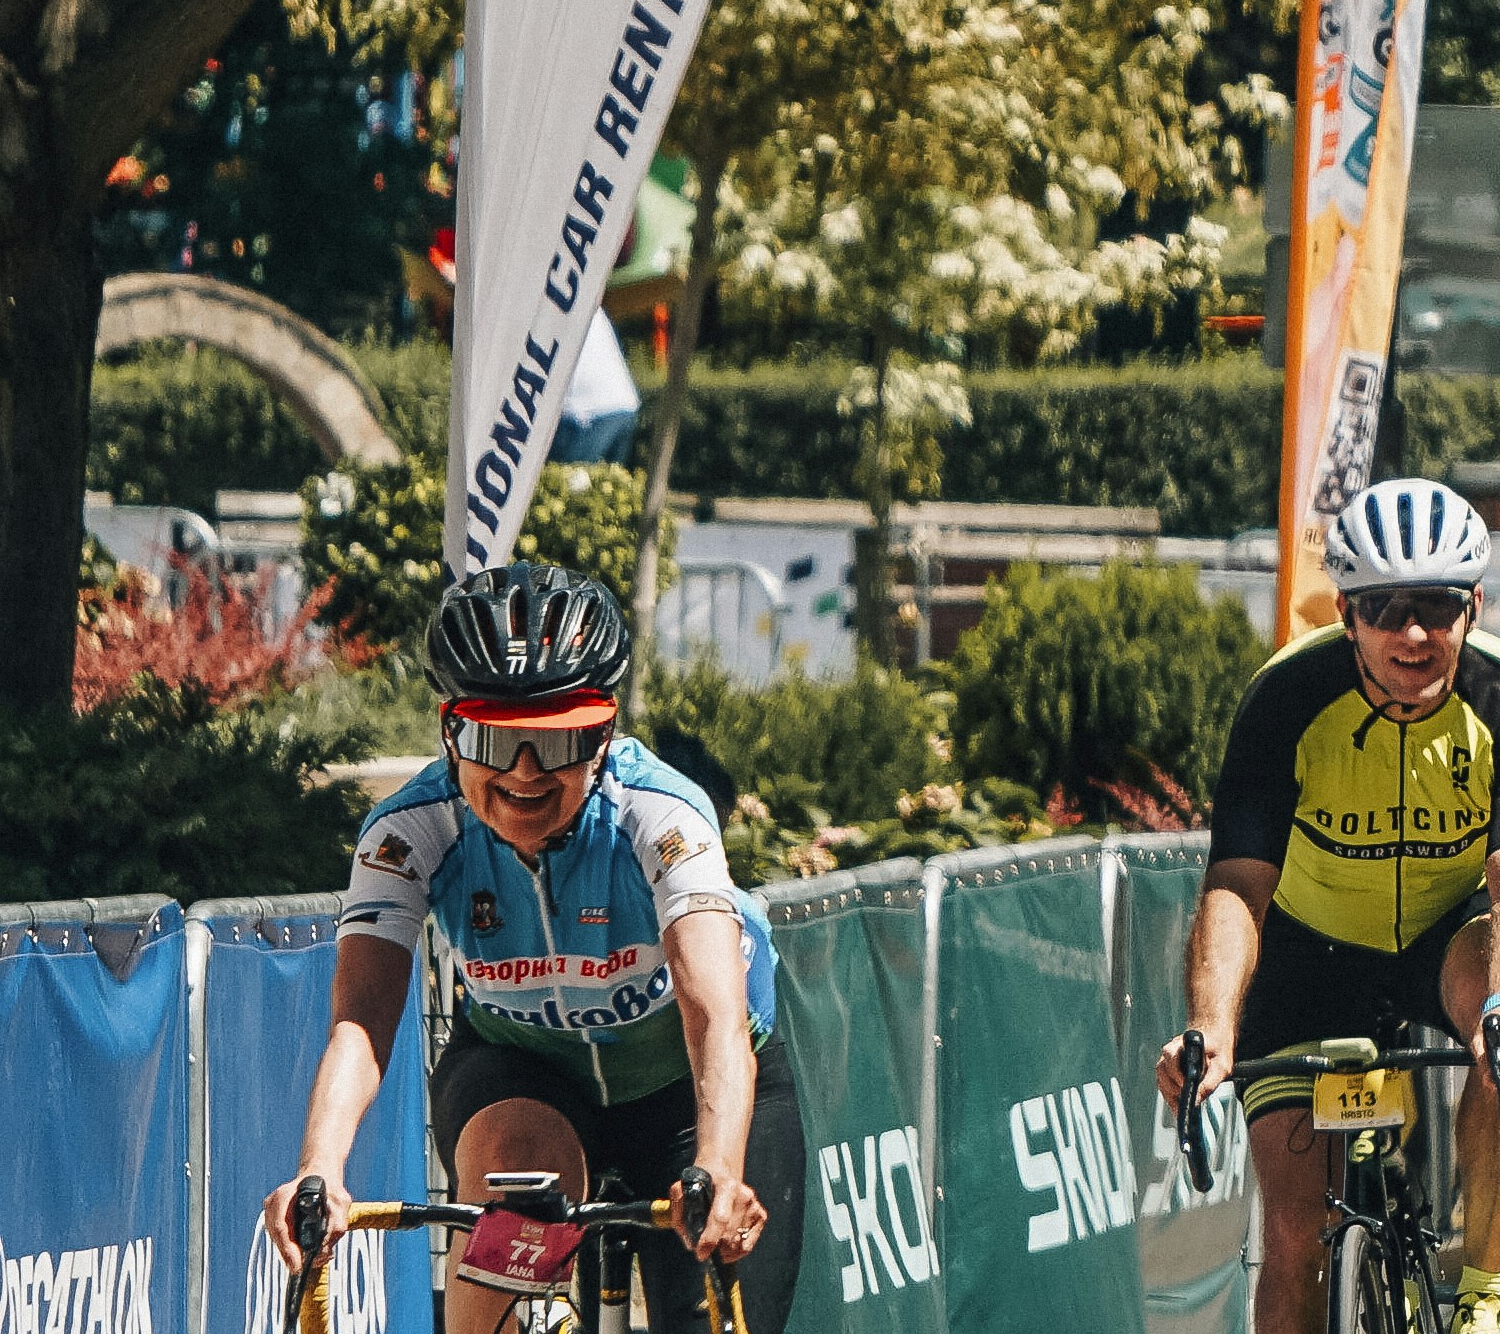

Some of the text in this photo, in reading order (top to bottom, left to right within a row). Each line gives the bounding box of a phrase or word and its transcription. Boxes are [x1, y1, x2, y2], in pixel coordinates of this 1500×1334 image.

[545, 157, 614, 315] CAR
[506, 655, 528, 675] 77
[1338, 1090, 1377, 1107] 113
[510, 1239, 546, 1264] 77
